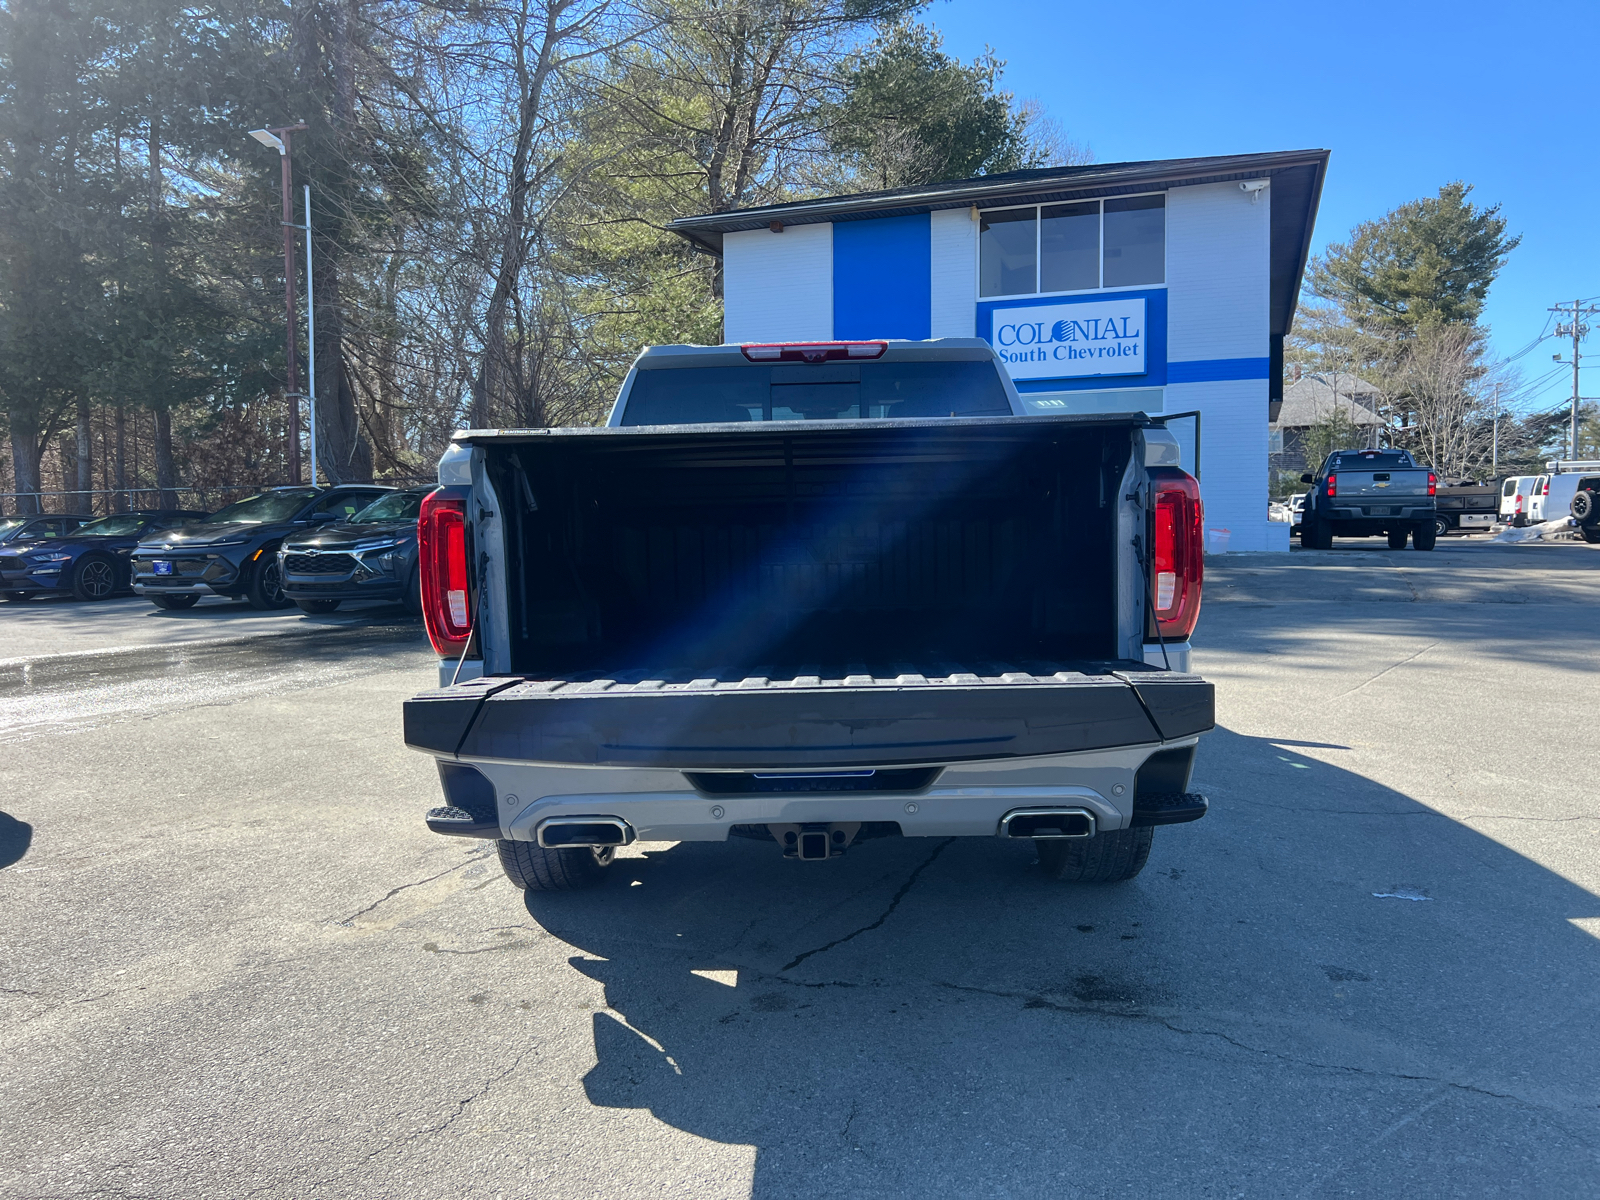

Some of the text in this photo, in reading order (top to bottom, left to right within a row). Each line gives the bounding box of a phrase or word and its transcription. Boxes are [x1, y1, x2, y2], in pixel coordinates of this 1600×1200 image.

[998, 317, 1140, 346] COLONIAL
[999, 342, 1139, 364] South Chevrolet
[761, 539, 878, 564] GMC
